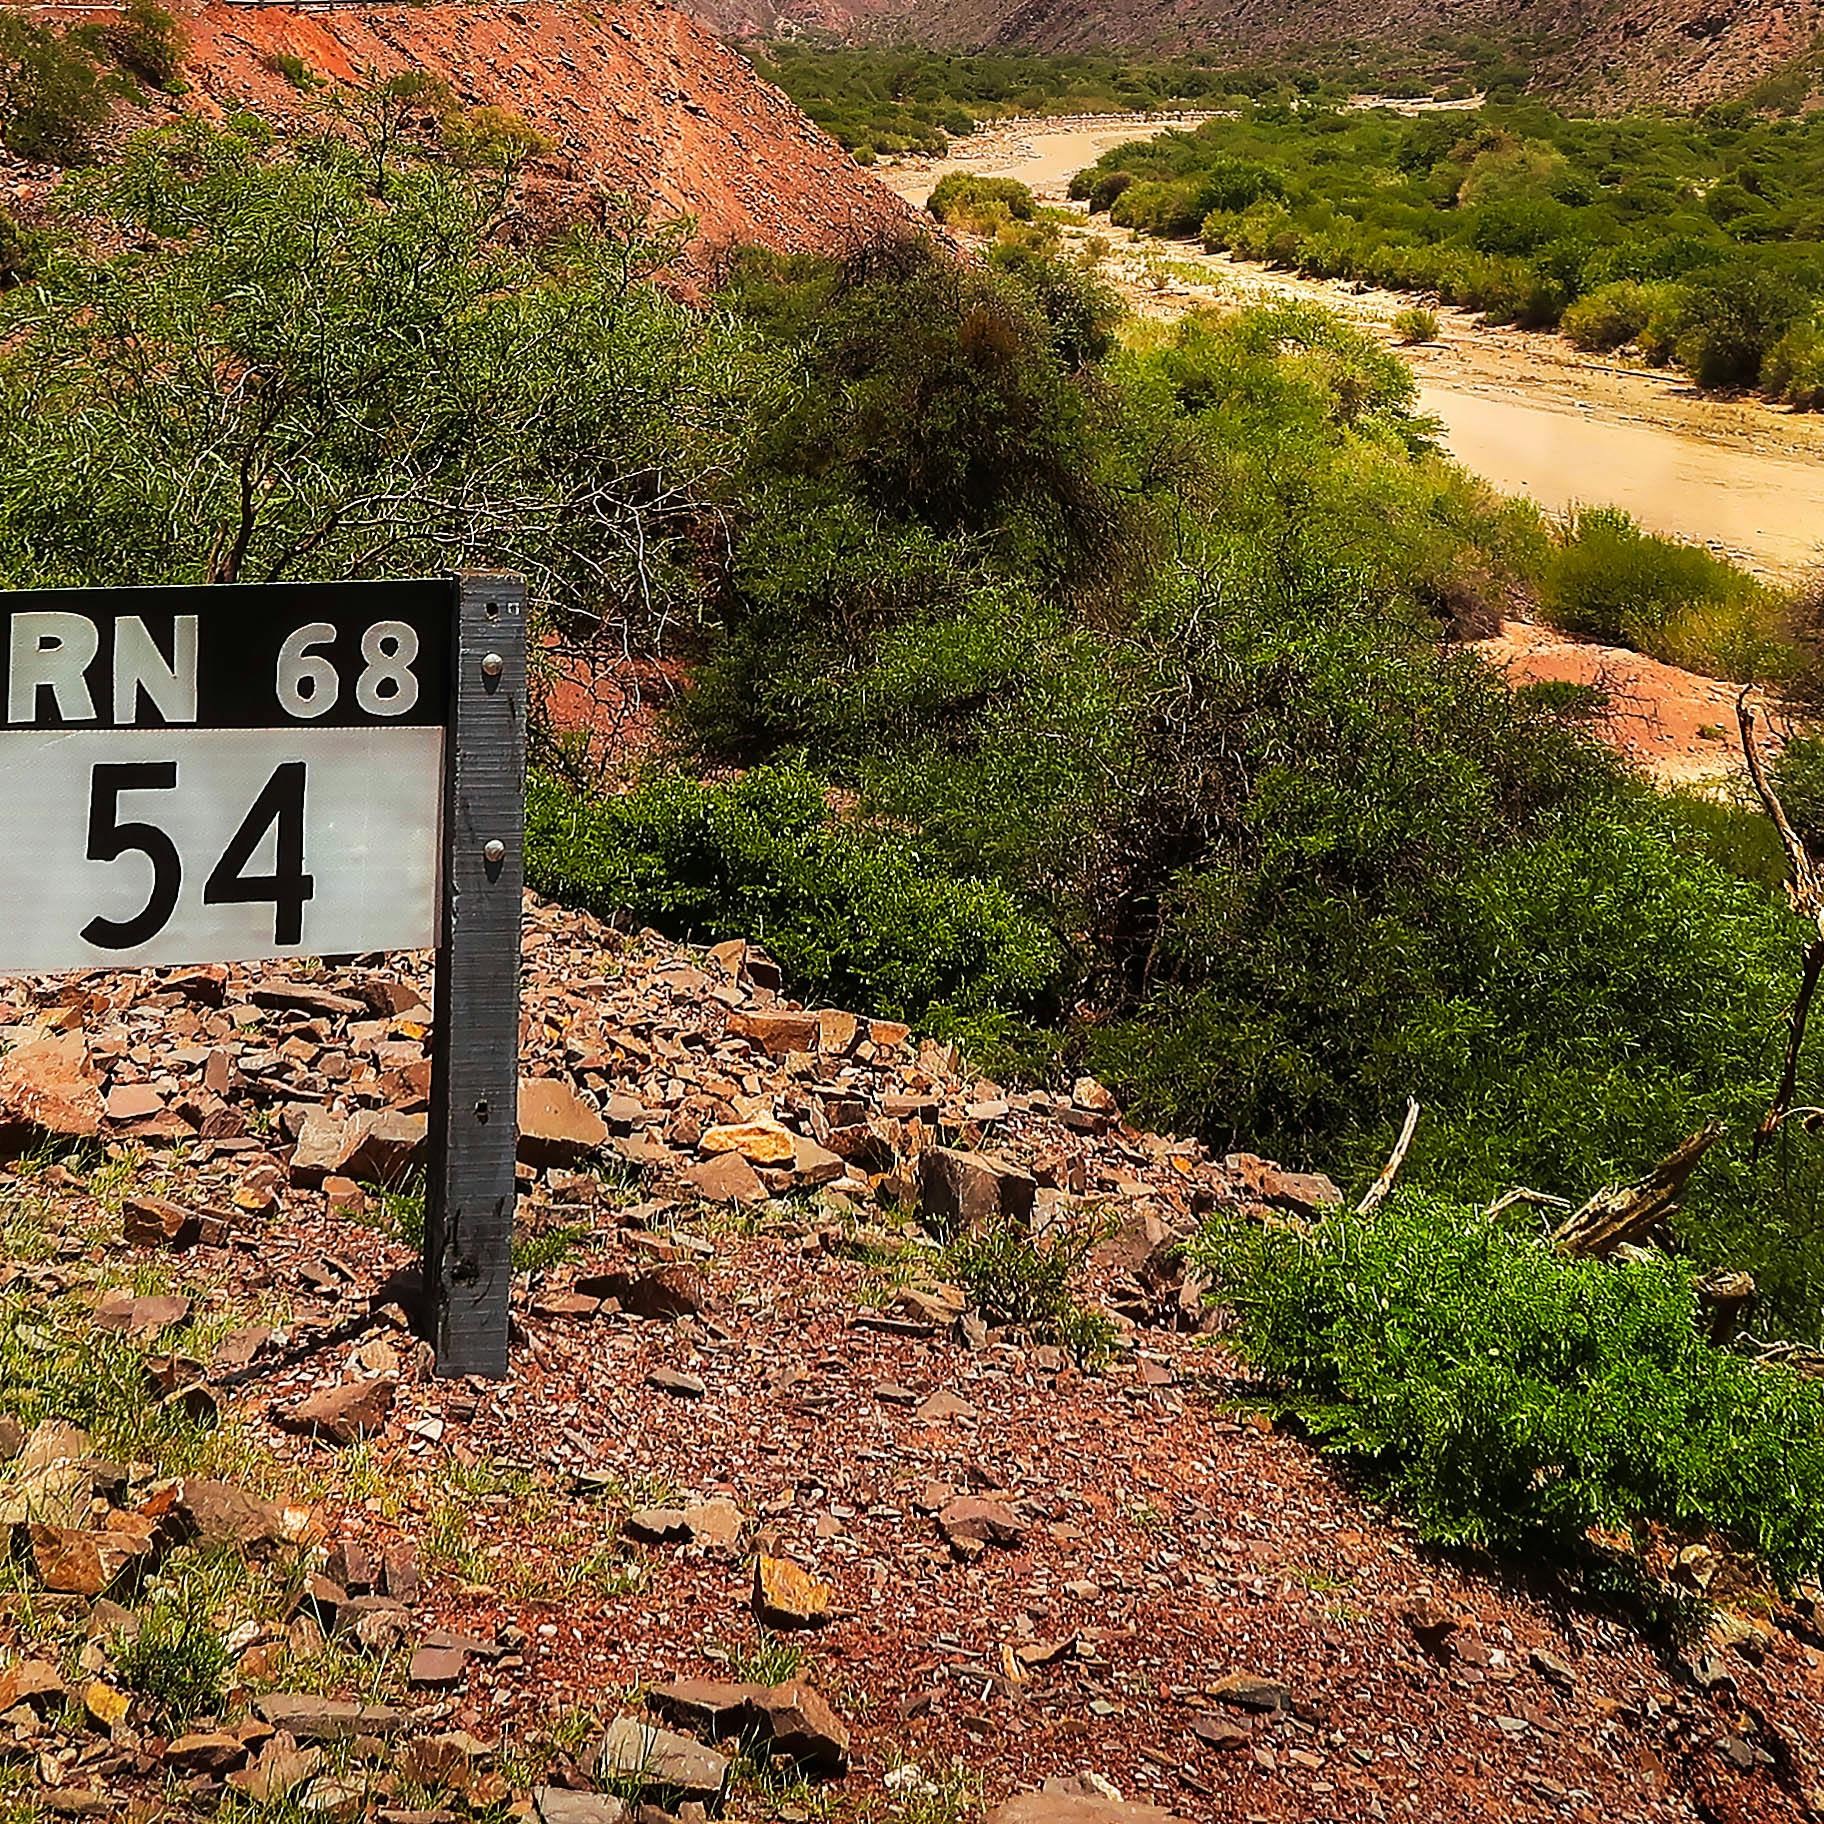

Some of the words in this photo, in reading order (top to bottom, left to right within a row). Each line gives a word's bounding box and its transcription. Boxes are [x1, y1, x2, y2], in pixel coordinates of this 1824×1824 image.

[7, 611, 199, 725] RN
[275, 621, 420, 719] 68
[79, 761, 314, 950] 54
